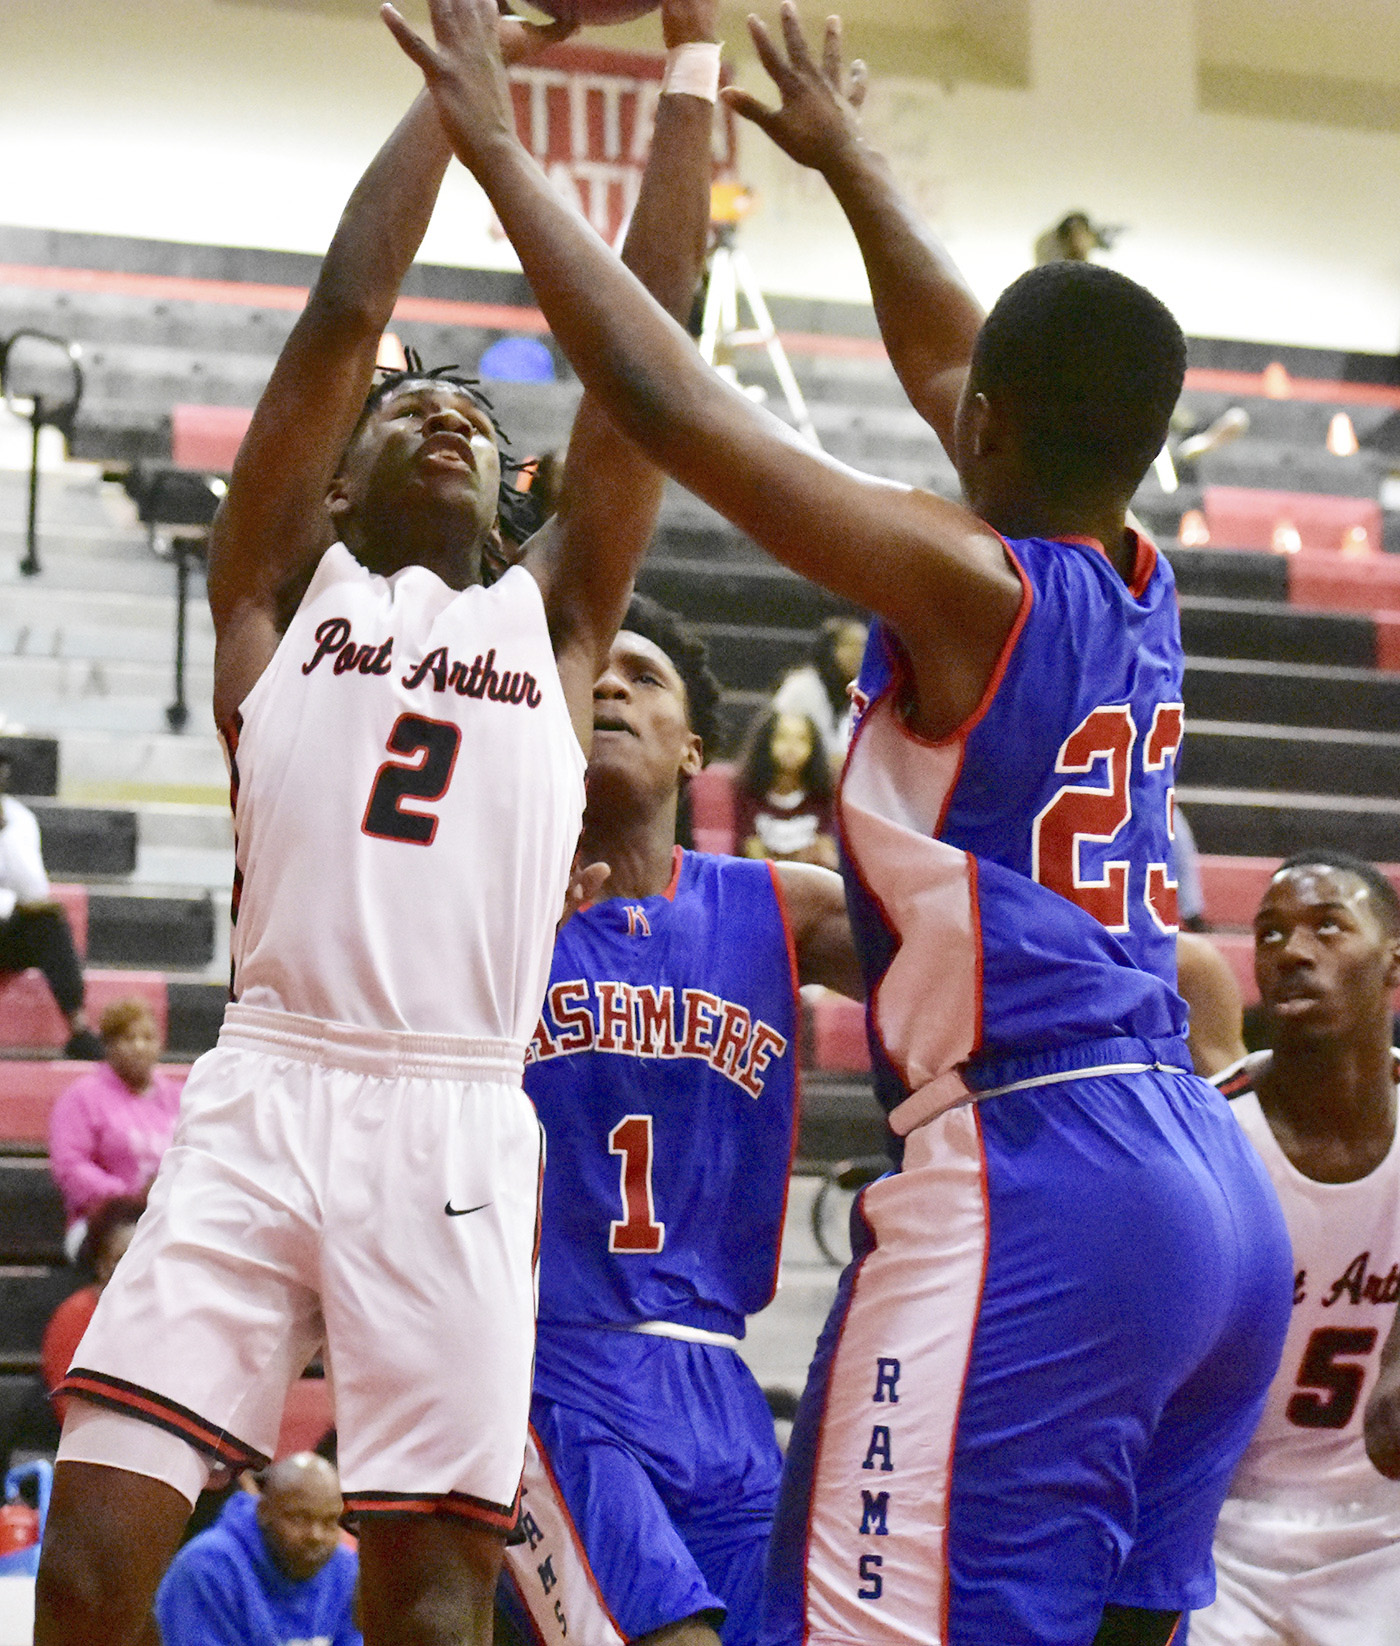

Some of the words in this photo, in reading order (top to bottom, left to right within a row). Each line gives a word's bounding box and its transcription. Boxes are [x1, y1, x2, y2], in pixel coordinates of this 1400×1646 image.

[302, 617, 394, 676] Port
[401, 646, 542, 709] Arthur
[361, 711, 462, 847] 2
[622, 904, 652, 937] K
[524, 978, 788, 1100] ASHMERE
[608, 1114, 666, 1254] 1
[1321, 1251, 1400, 1307] Art
[1285, 1326, 1379, 1430] 5
[857, 1357, 901, 1600] RAMS
[521, 1487, 568, 1638] AMS
